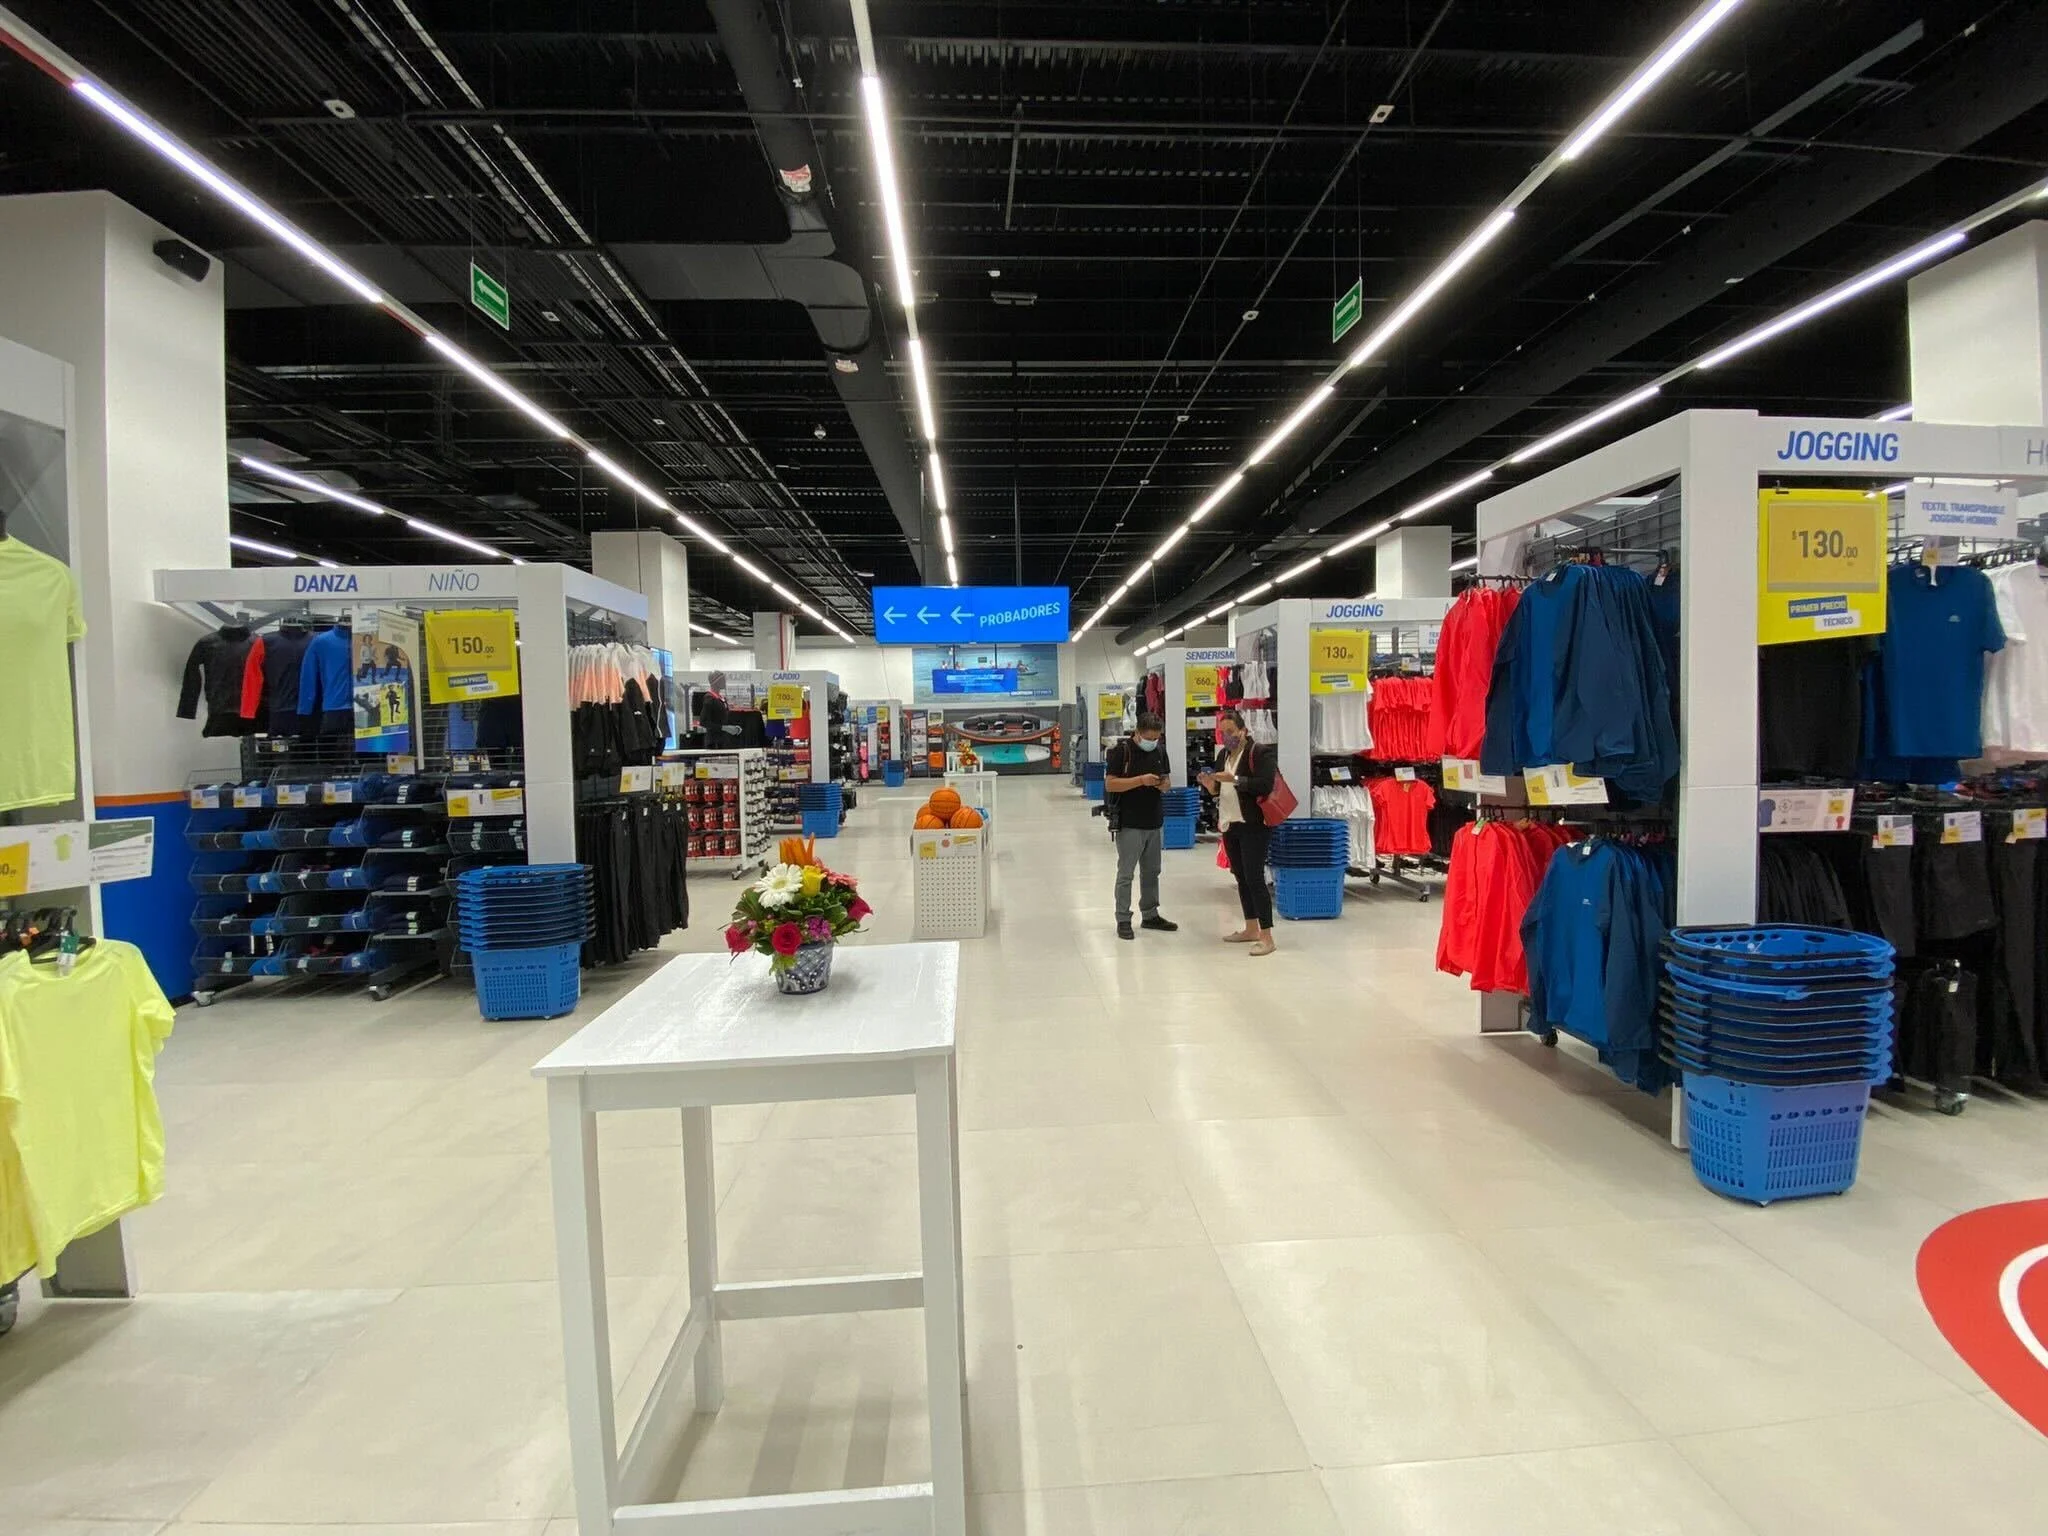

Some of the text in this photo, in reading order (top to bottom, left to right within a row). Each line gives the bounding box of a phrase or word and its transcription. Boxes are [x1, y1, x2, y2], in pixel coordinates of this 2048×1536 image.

[1777, 431, 2048, 465] JOGGING H
[1921, 501, 1948, 512] TEXTIL
[1929, 514, 1998, 526] JOGGING HOMBRE
[1792, 530, 1858, 558] $130.00
[294, 569, 480, 593] DANZA NIÑO
[1326, 604, 1384, 618] JOGGING
[1790, 601, 1847, 613] PRIMER PRECIO
[979, 602, 1061, 628] PROBADORES
[448, 636, 494, 656] $150.00
[1185, 650, 1235, 660] SENDERISM
[772, 672, 800, 680] CARDIO
